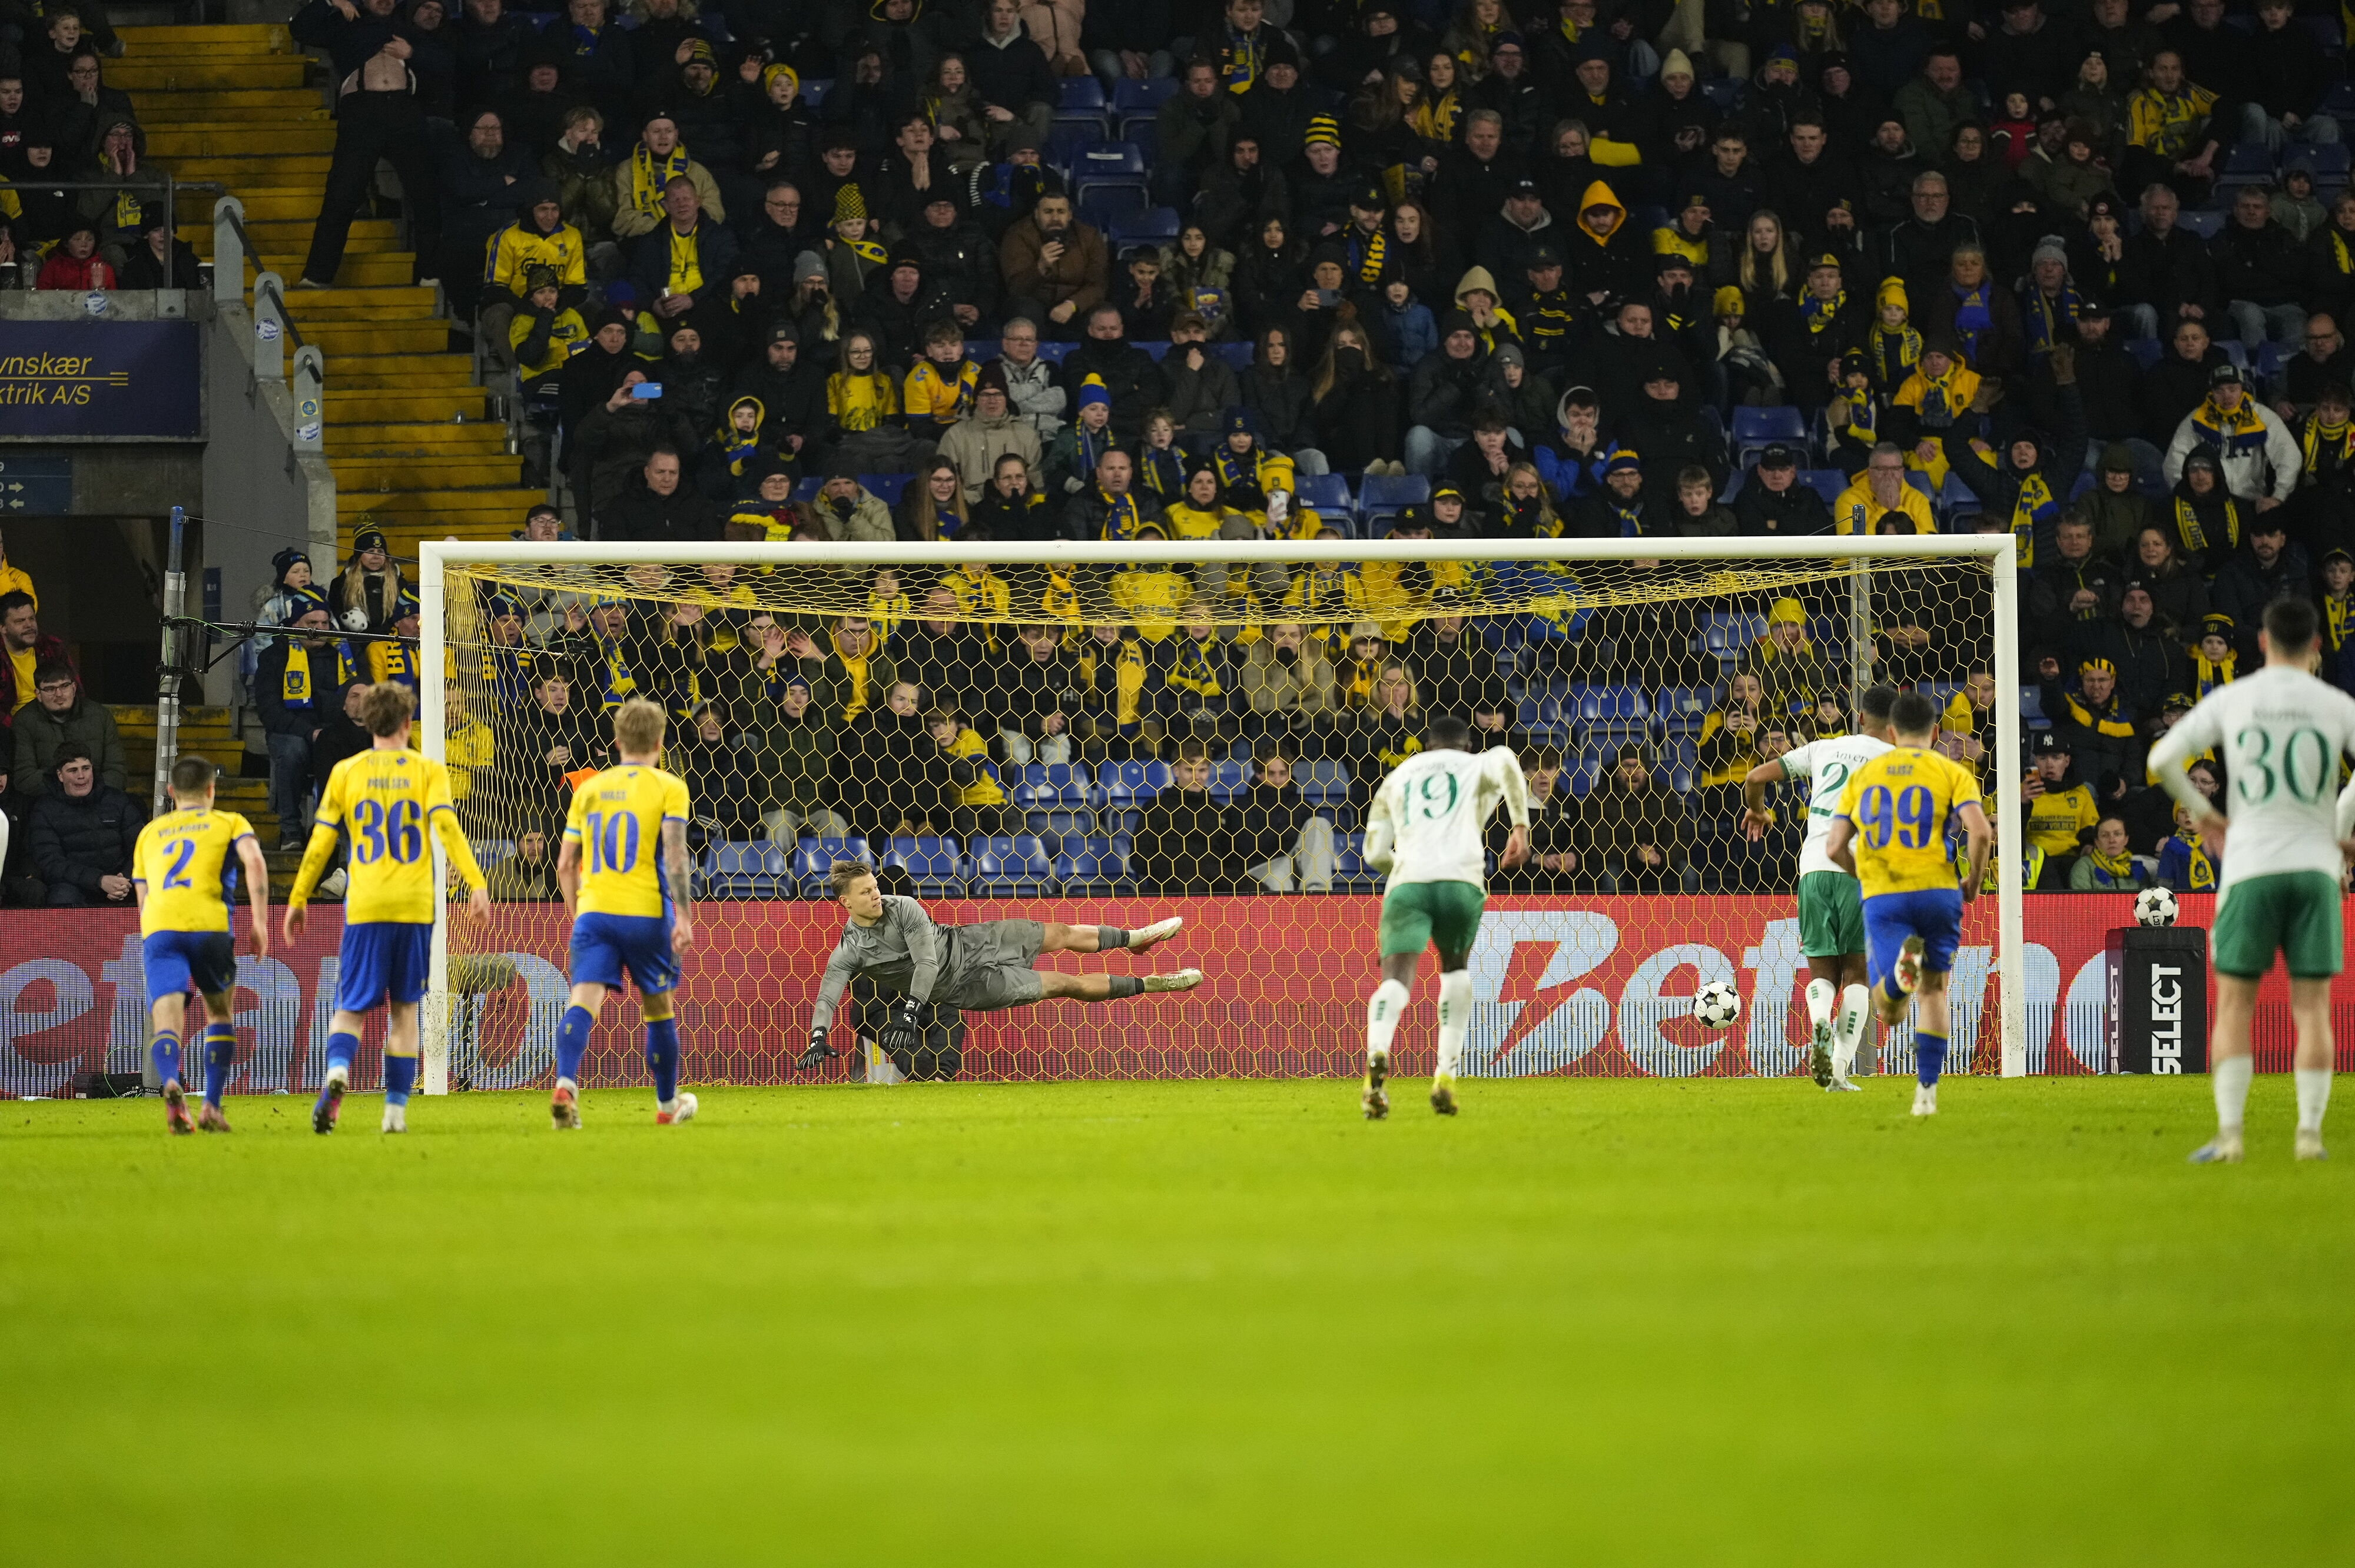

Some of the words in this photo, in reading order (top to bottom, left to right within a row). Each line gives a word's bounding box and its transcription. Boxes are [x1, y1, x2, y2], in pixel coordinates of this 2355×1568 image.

[50, 384, 92, 405] A/S
[387, 626, 406, 675] BR
[1810, 762, 1849, 817] 2
[2238, 726, 2330, 805] 30
[1403, 771, 1457, 826] 19
[1859, 785, 1934, 849] 99
[355, 799, 422, 864] 36
[587, 809, 639, 874] 10
[162, 839, 196, 891] 2
[1457, 911, 2107, 1078] Betn
[2151, 963, 2182, 1075] SELECT
